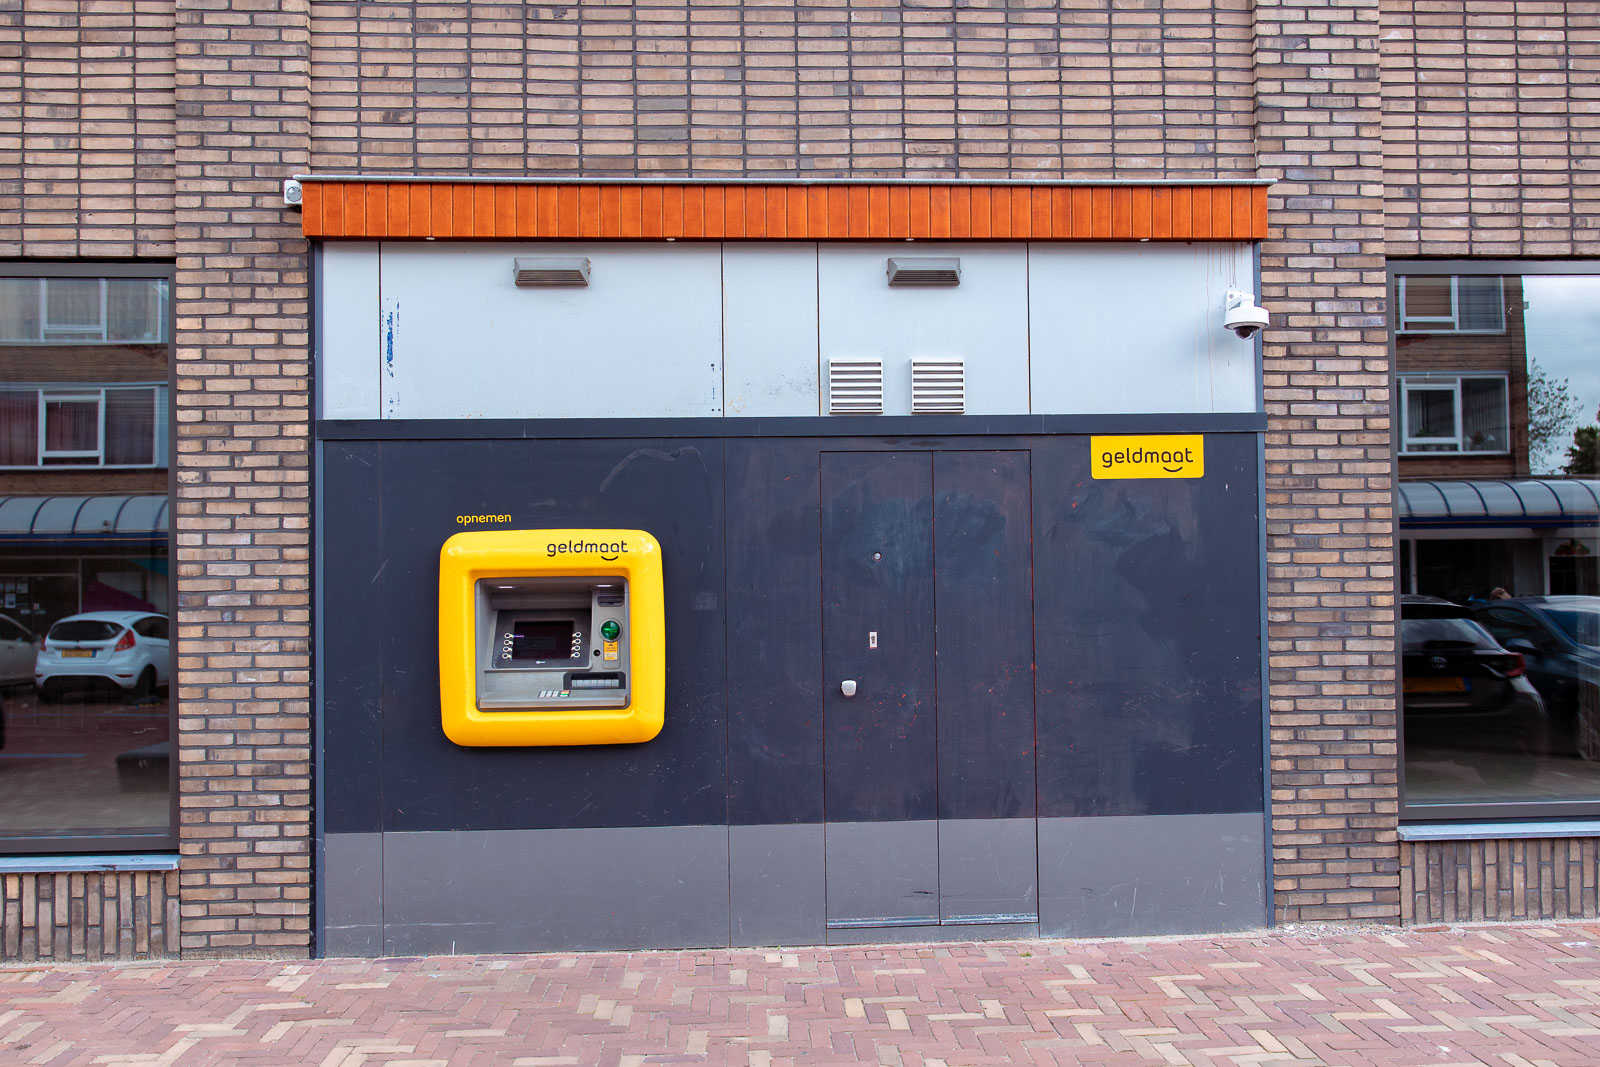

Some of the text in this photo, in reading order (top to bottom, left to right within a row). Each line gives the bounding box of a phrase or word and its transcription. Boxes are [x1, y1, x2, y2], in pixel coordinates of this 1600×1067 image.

[1102, 447, 1194, 469] geldmaat
[456, 514, 512, 527] opnemen
[547, 540, 629, 558] geldmaat
